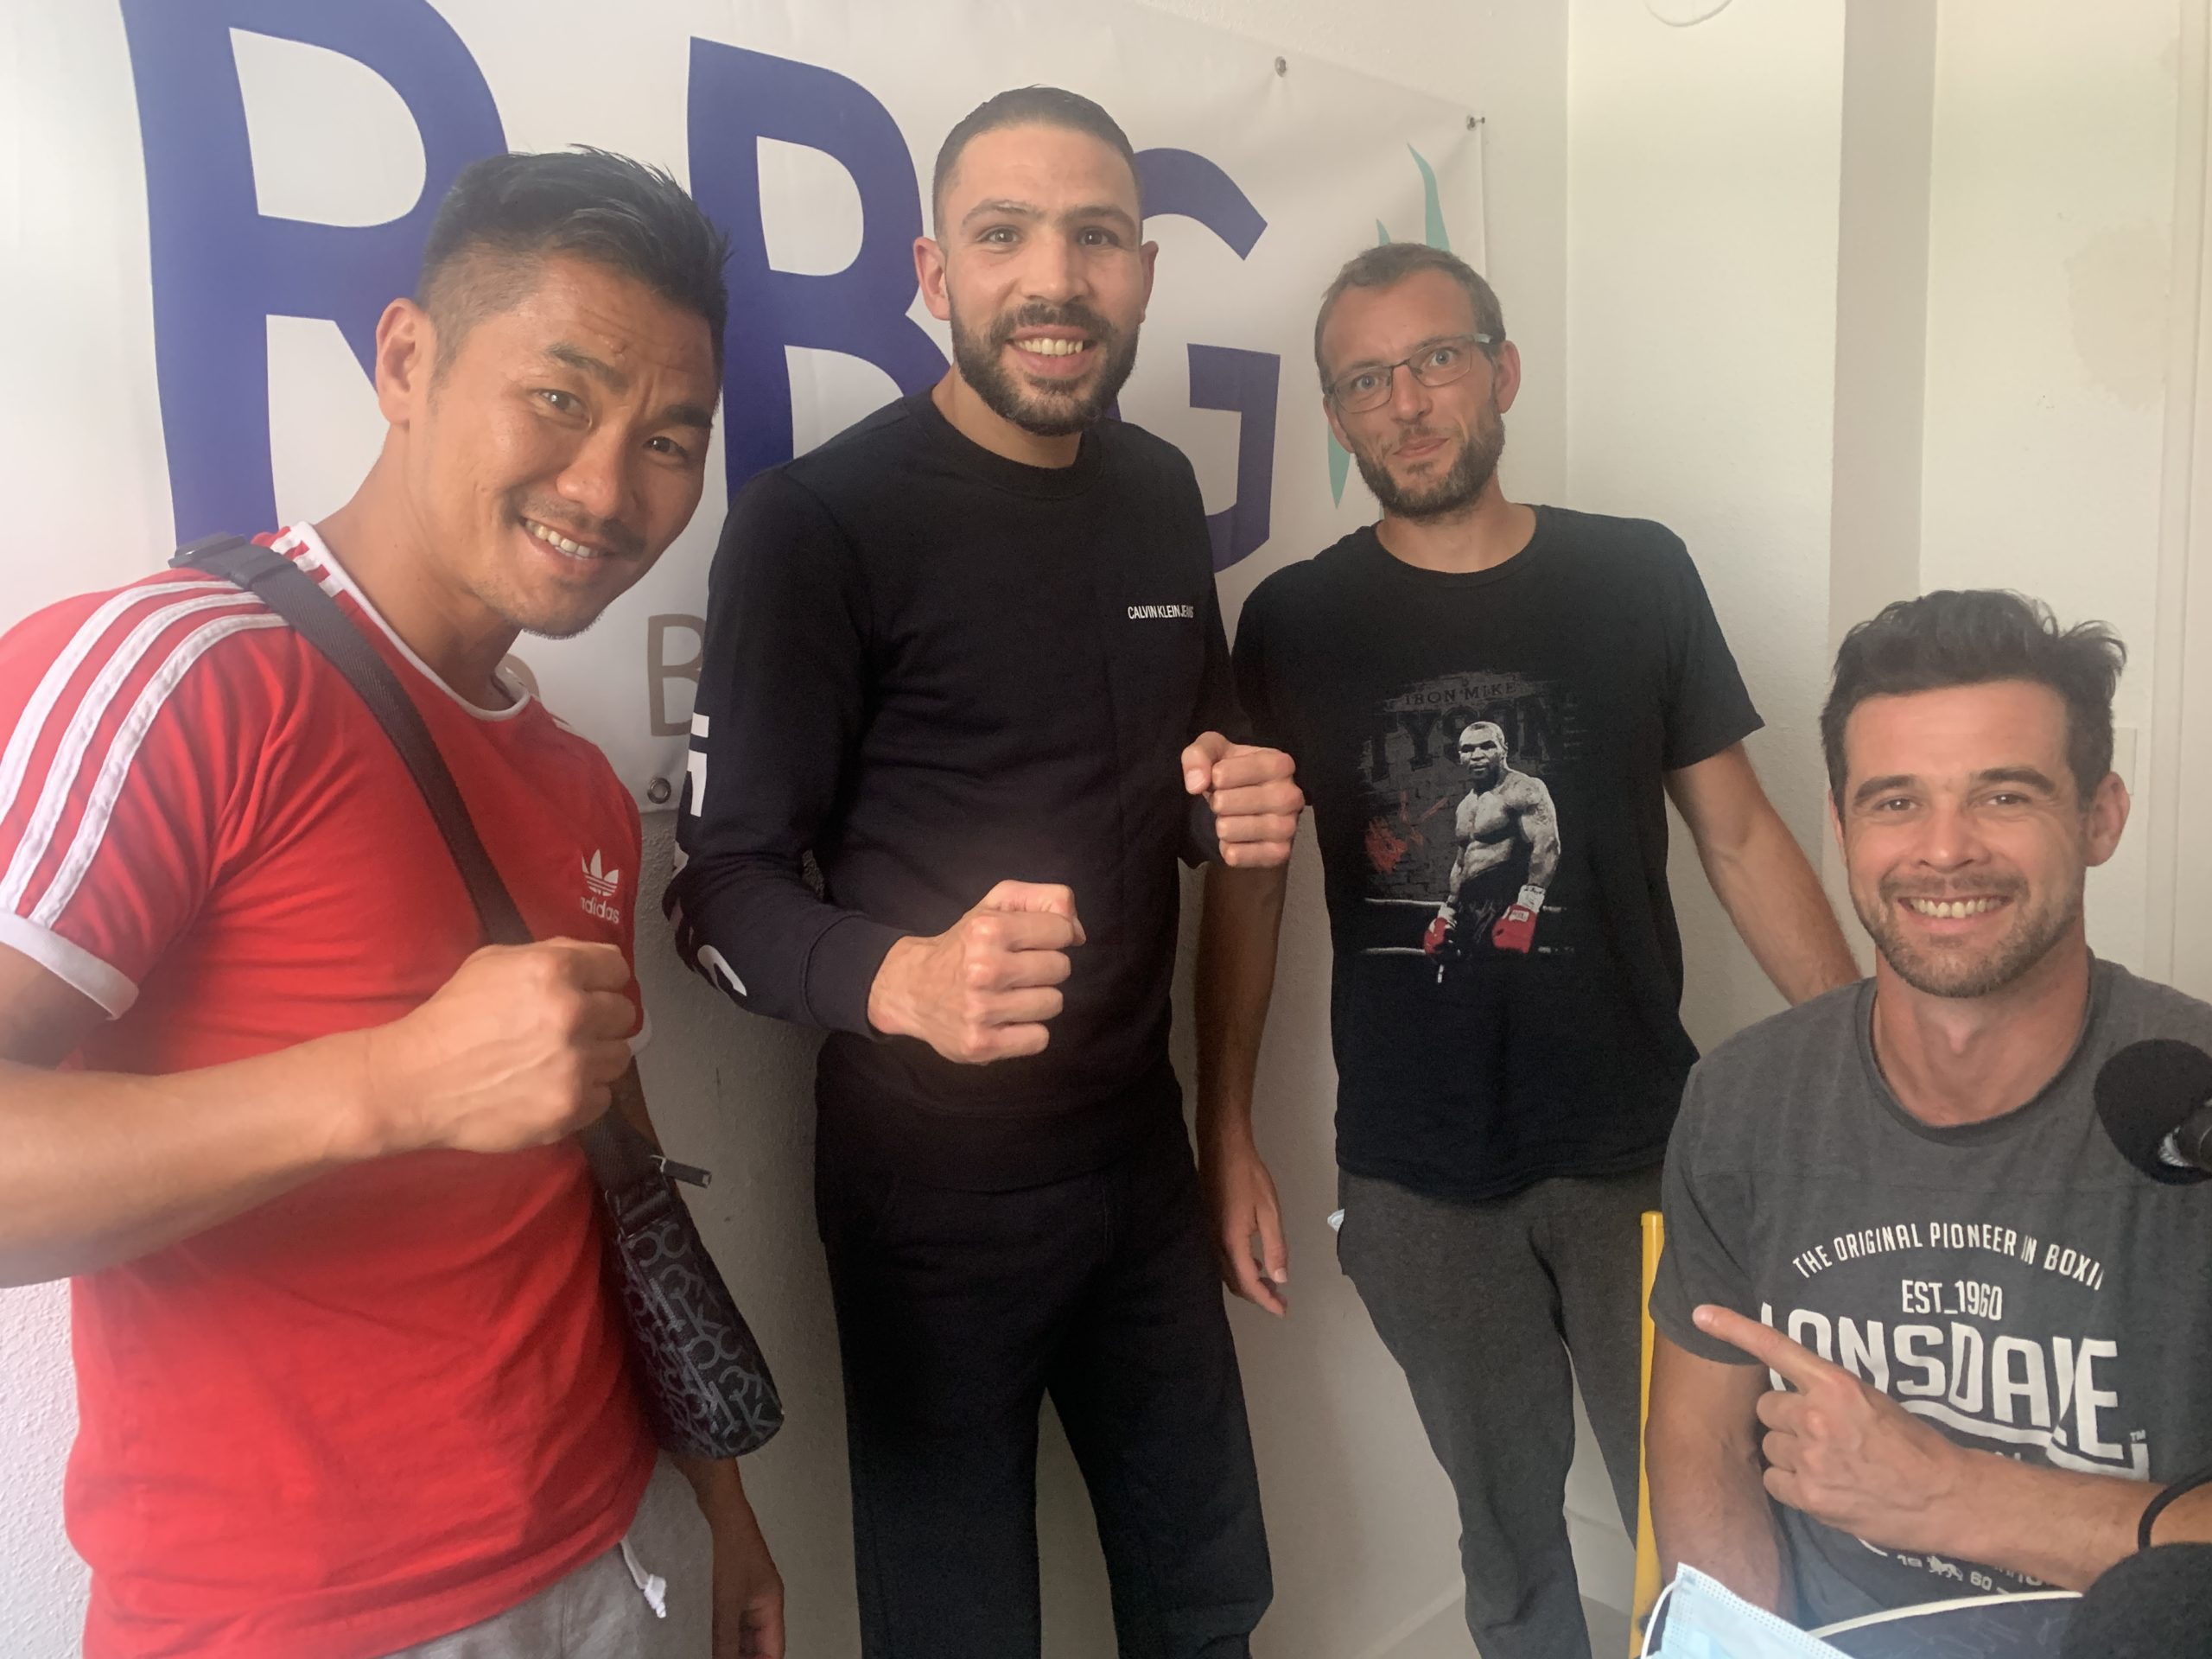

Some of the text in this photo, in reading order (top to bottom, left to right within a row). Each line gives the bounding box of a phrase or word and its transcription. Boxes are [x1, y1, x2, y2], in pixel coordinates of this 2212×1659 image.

[1127, 605, 1158, 620] CALVIN
[1158, 604, 1181, 619] KLEIN
[1404, 681, 1517, 705] IRON MIKE
[1792, 1244, 1833, 1279] THE
[1833, 1223, 1923, 1262] ORIGINAL
[1929, 1222, 2018, 1256] PIONEER
[2020, 1235, 2037, 1265] IN
